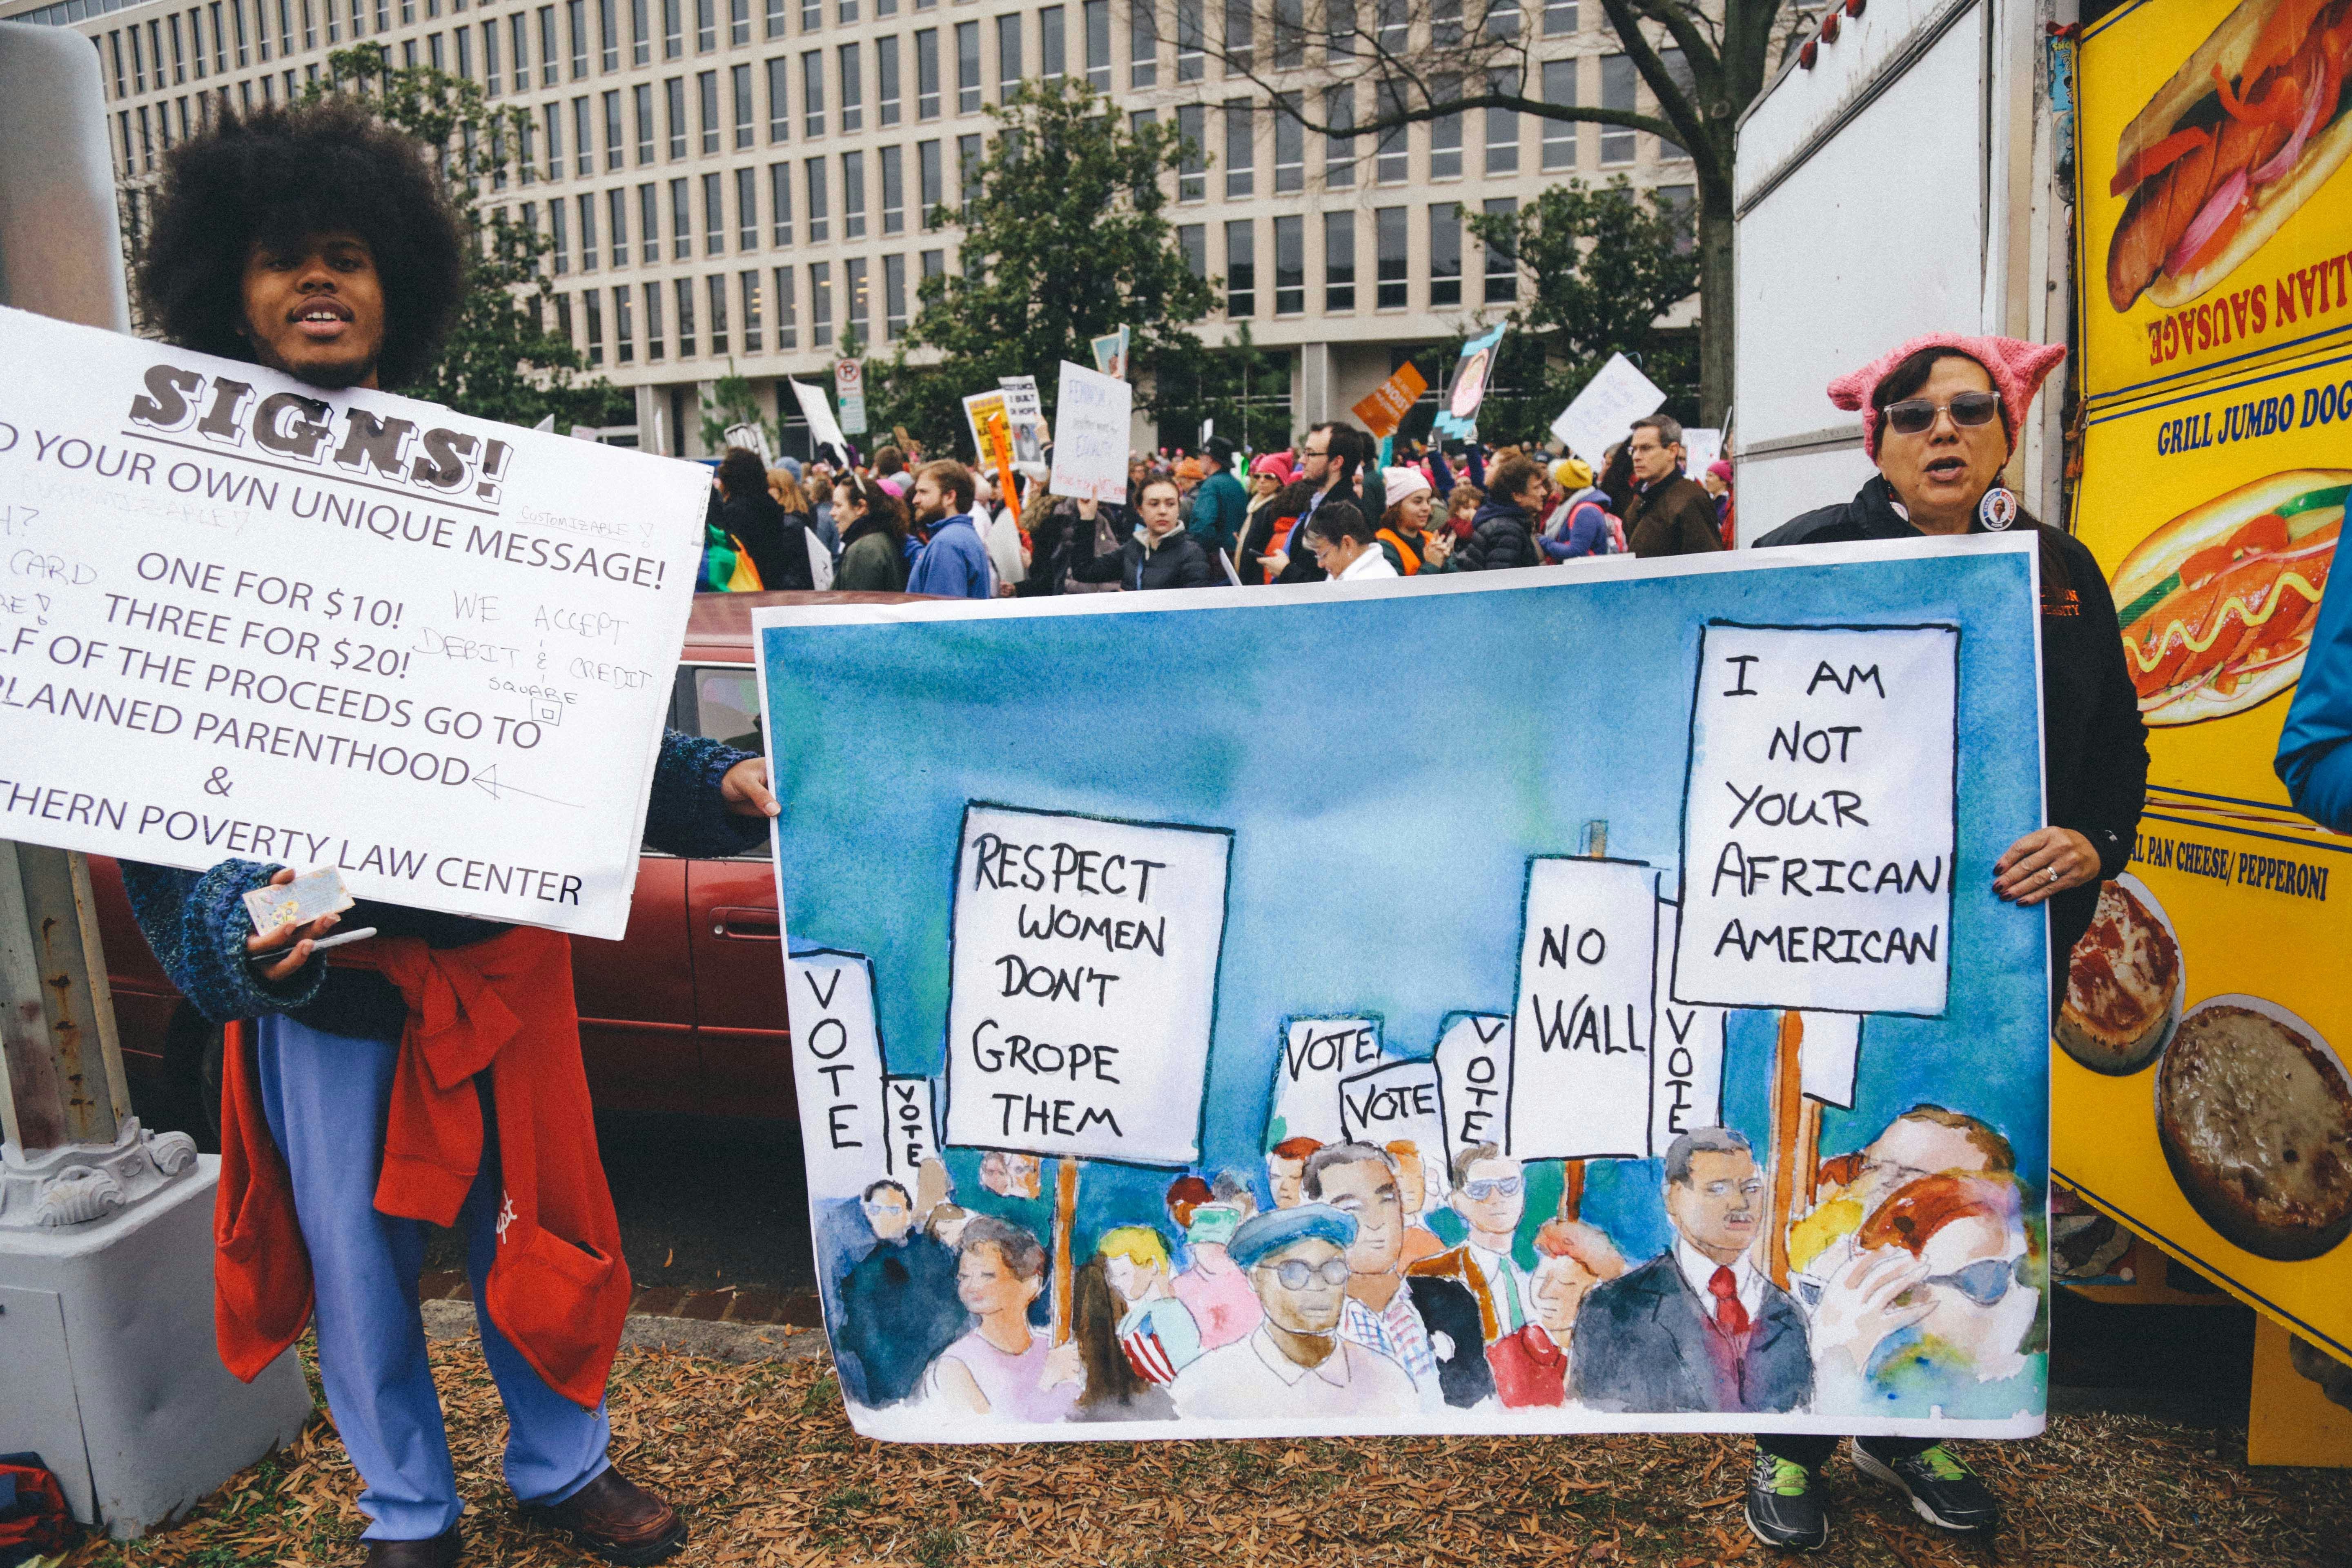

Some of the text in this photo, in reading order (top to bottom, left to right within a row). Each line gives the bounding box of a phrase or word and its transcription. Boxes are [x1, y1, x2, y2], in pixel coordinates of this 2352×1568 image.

[2148, 250, 2352, 366] LIAN SAUSAGE
[129, 364, 514, 505] SIGNS!
[2158, 380, 2352, 456] GRILL JUMBO DOG
[35, 430, 156, 485] YOUR
[168, 462, 279, 510] OWN
[292, 487, 457, 548] UNIQUE
[465, 525, 666, 590] MESSAGE!
[11, 549, 97, 585] CARD
[137, 552, 403, 630] ONE FOR $10!
[105, 593, 410, 679] THREE FOR $20!
[454, 590, 630, 644] WE ACCEPT
[0, 627, 541, 749] F OF THE PROCEEDS GO TO
[412, 627, 520, 668] DEBIT
[570, 657, 653, 689] CREDIT
[1723, 655, 1885, 699] I AM
[489, 677, 578, 705] SQUARE
[0, 675, 469, 786] LANNED PARENTHOOD
[1768, 720, 1862, 764] NOT
[204, 766, 233, 797] &
[1725, 780, 1869, 829] YOUR
[138, 805, 330, 864] POVERTY
[338, 840, 428, 880] LAW
[436, 856, 583, 906] CENTER
[972, 833, 1166, 903] RESPECT
[1712, 841, 1941, 897] AFRICAN
[2147, 836, 2174, 869] PAN
[2238, 853, 2330, 901] PEPPERONI
[1018, 904, 1165, 956] WOMEN
[1539, 924, 1606, 969] NO
[1713, 918, 1938, 965] AMERICAN
[995, 954, 1120, 1007] DON'T
[972, 1019, 1120, 1084] GROPE
[1285, 1027, 1374, 1082] VOTE
[1532, 993, 1646, 1056] WALL
[804, 968, 863, 1149] VOTE
[1460, 1016, 1505, 1144] VOTE
[1664, 1007, 1697, 1134] VOTE
[894, 1084, 923, 1168] VOTE
[992, 1093, 1123, 1137] THEM
[1346, 1083, 1436, 1128] VOTE
